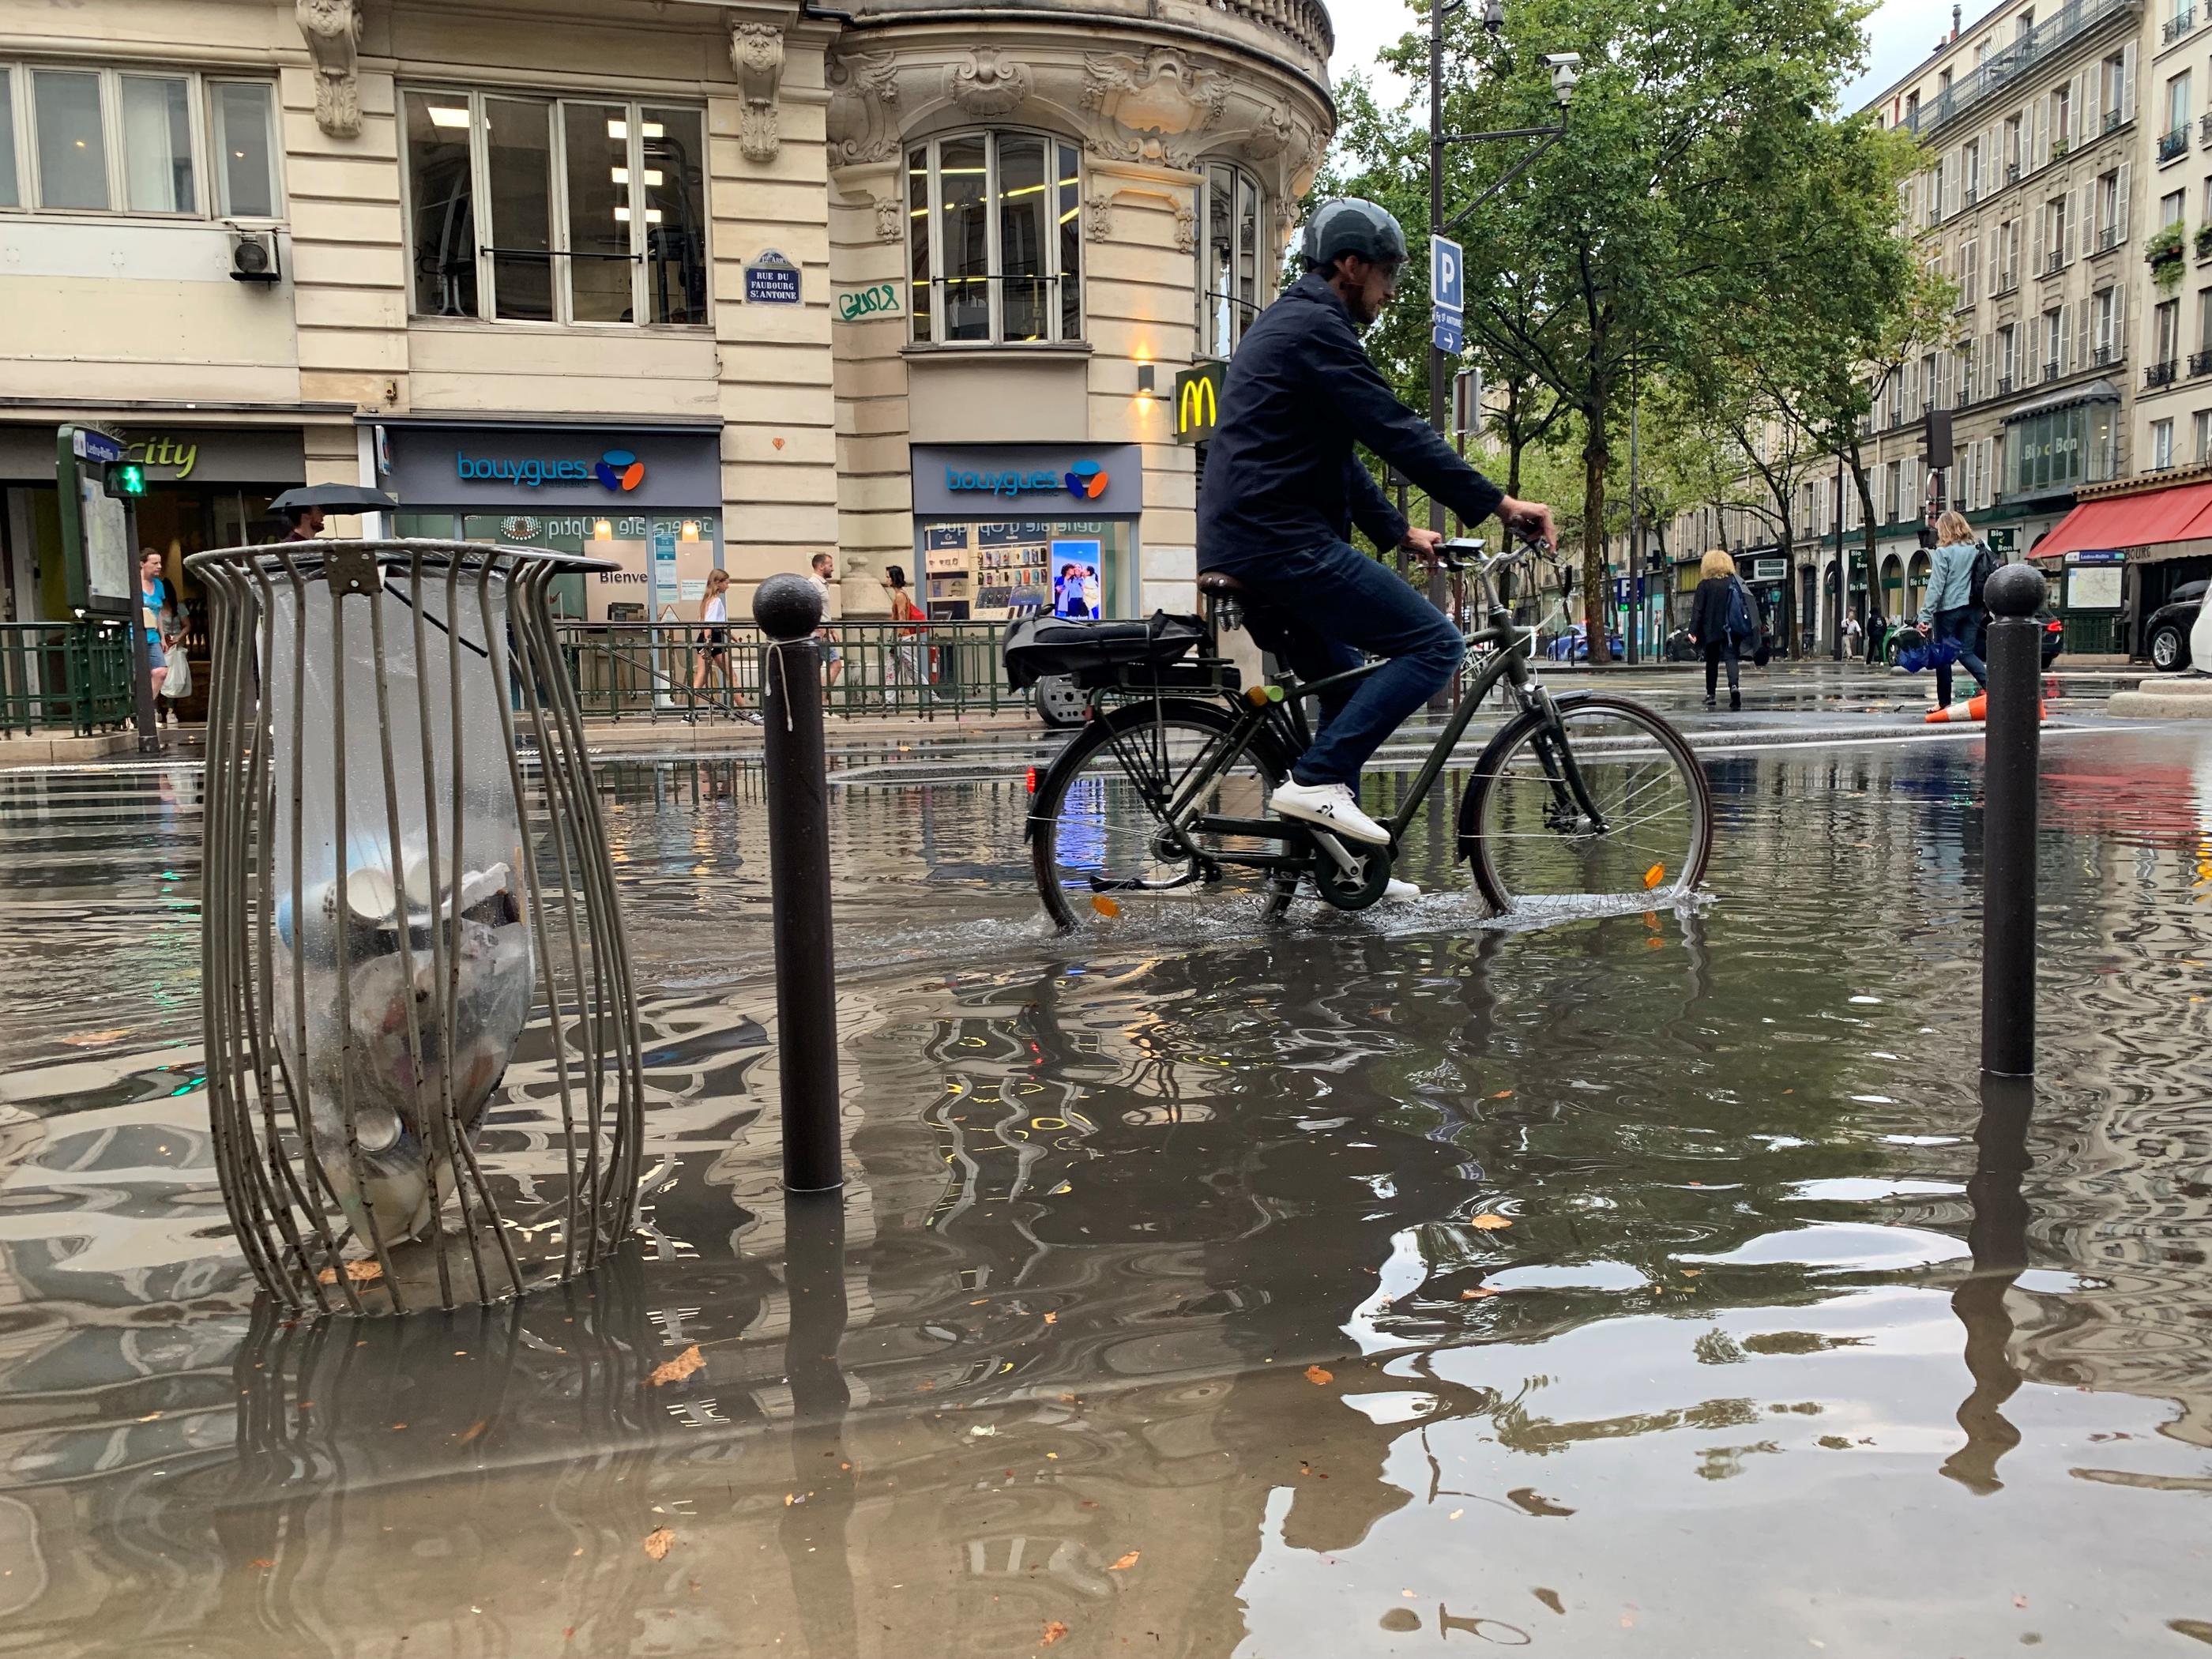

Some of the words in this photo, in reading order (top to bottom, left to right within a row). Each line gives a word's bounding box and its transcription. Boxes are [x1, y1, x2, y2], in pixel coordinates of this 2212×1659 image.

[1442, 252, 1455, 293] P
[750, 281, 795, 291] FAUBOURG
[759, 291, 797, 299] ANTOINE
[2025, 442, 2041, 460] Bio
[2056, 437, 2078, 454] Bon
[457, 450, 589, 487] bouygues
[946, 462, 1059, 496] bouygues
[600, 572, 648, 583] Bienve
